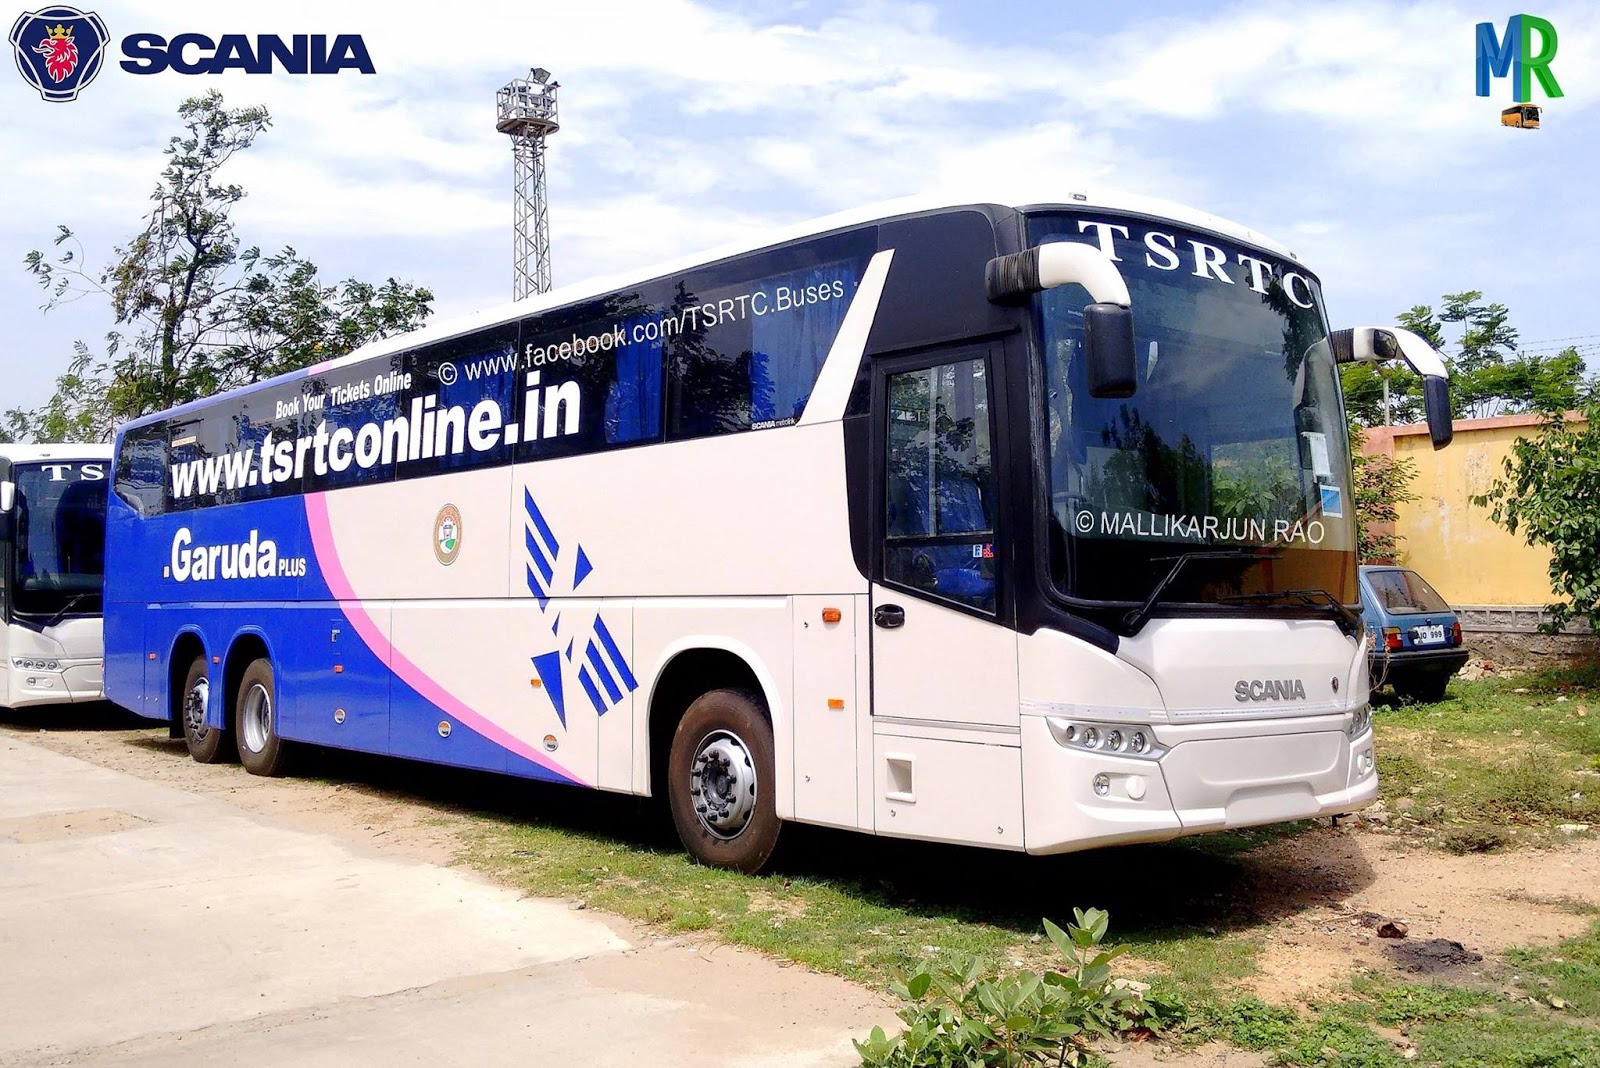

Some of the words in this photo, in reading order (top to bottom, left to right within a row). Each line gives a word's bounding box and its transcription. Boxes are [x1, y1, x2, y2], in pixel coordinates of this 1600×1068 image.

[1077, 220, 1314, 310] TSRTC
[275, 397, 300, 420] Book
[303, 393, 326, 413] Your
[331, 379, 371, 406] Tickets
[374, 370, 412, 396] Online
[171, 370, 581, 499] www.tsrtconline.in
[751, 420, 776, 430] SCANIA
[278, 558, 306, 577] PLUS
[1234, 679, 1306, 701] SCANIA
